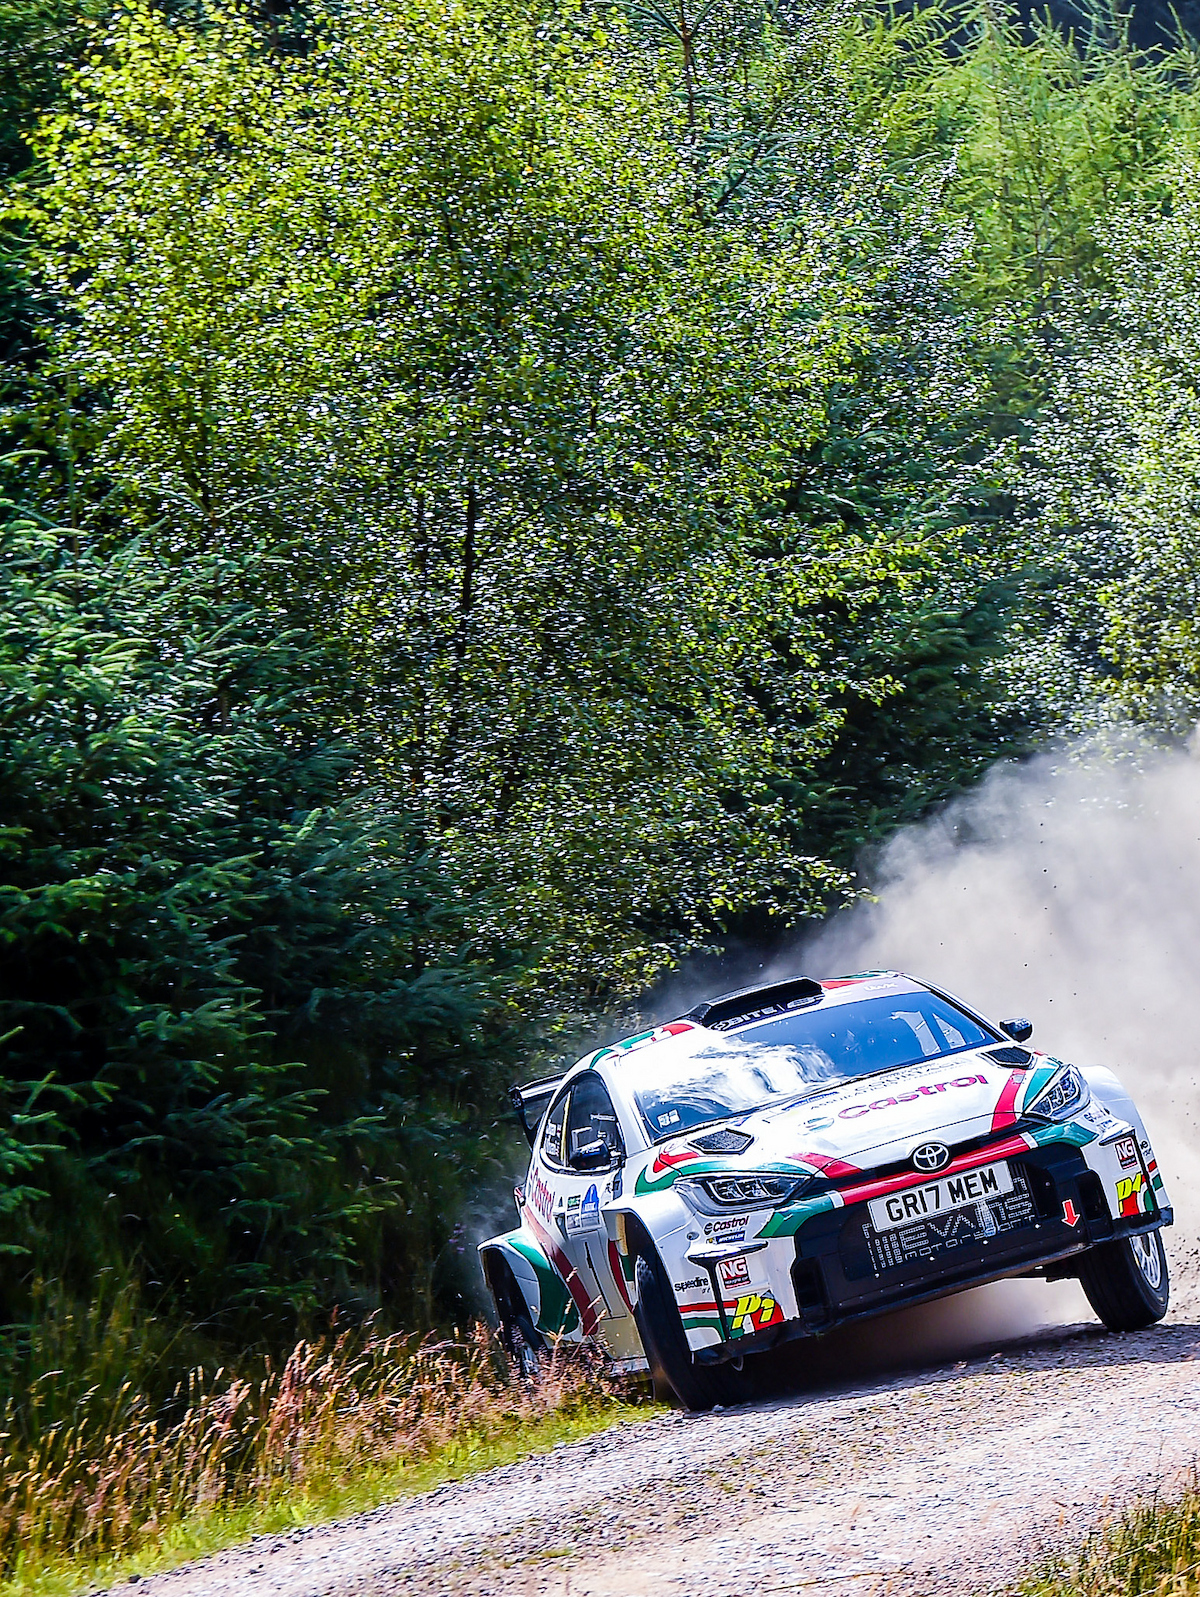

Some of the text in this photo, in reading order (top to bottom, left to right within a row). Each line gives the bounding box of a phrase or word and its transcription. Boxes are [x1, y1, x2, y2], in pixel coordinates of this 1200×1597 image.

[837, 1074, 989, 1120] Castrol
[1116, 1139, 1135, 1160] NG
[885, 1168, 999, 1222] GR17 MEM
[712, 1215, 750, 1233] Castrol
[720, 1258, 748, 1279] NG
